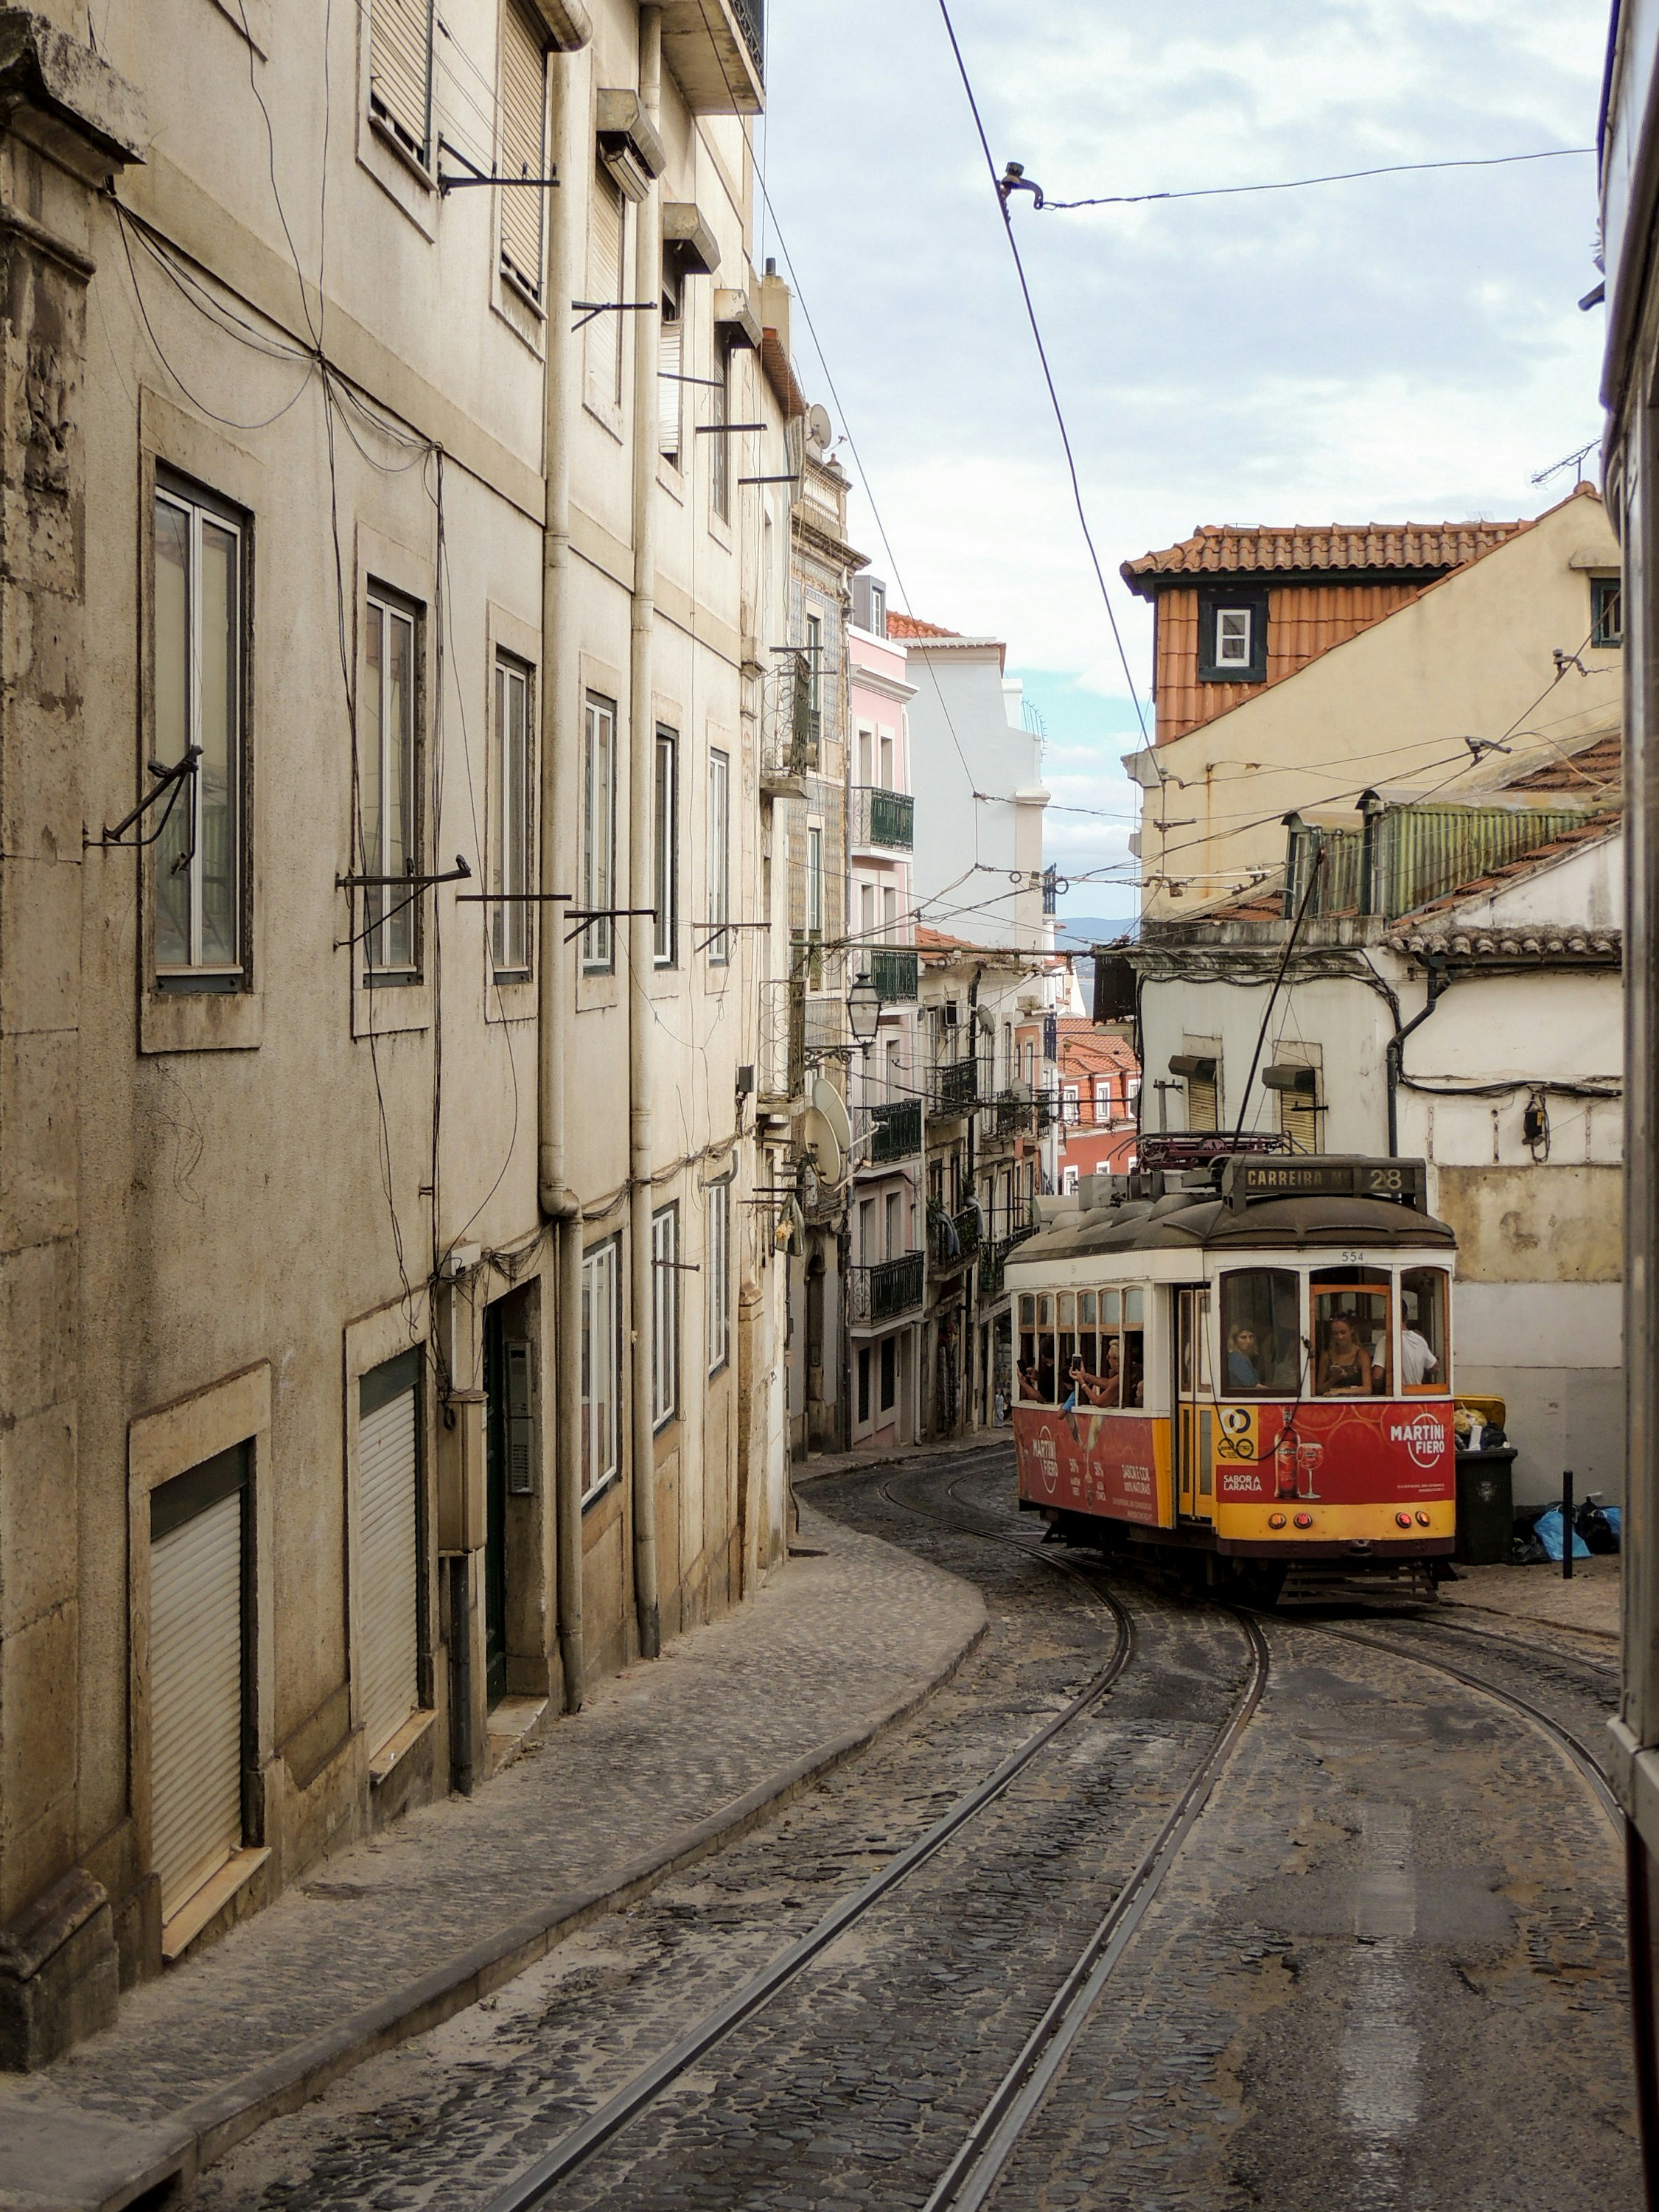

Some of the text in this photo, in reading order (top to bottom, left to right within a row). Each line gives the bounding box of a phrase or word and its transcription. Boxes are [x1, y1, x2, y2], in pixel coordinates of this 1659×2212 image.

[1248, 1170, 1322, 1186] CARREIRA
[1370, 1169, 1403, 1190] 28
[1341, 1252, 1363, 1262] 554
[1391, 1425, 1444, 1441] MARTINI
[1033, 1438, 1056, 1459] MARTINI
[1416, 1440, 1445, 1454] FIERO
[1043, 1459, 1058, 1478] FIERO
[1223, 1474, 1251, 1483] SABOR
[1223, 1482, 1262, 1491] LARANJA
